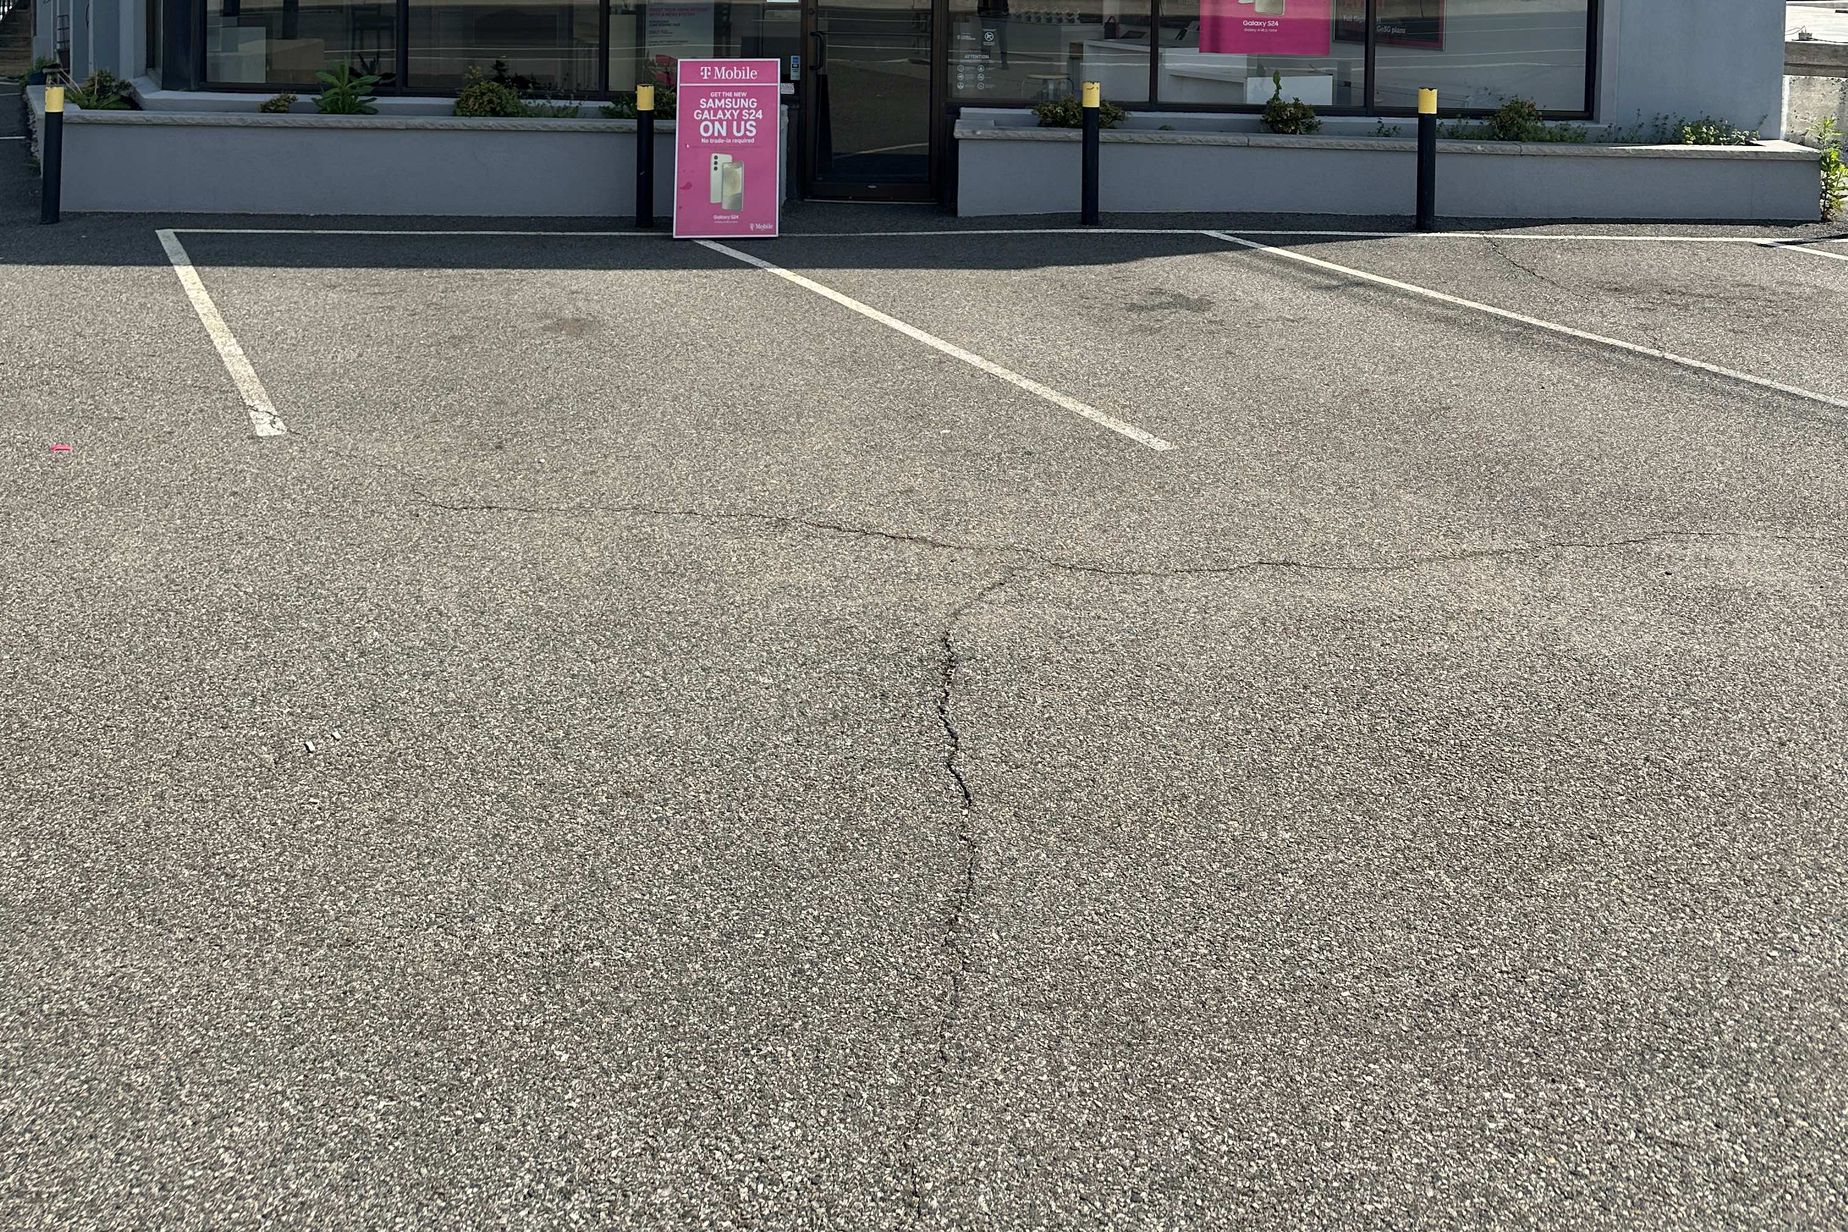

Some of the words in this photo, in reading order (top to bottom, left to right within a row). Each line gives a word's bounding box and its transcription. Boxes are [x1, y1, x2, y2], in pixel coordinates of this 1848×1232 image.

[714, 67, 758, 80] Mobile
[700, 98, 757, 109] SAMSUNG
[694, 110, 740, 120] GALAXY
[742, 110, 763, 120] S24
[700, 121, 727, 137] ON
[733, 121, 757, 137] US
